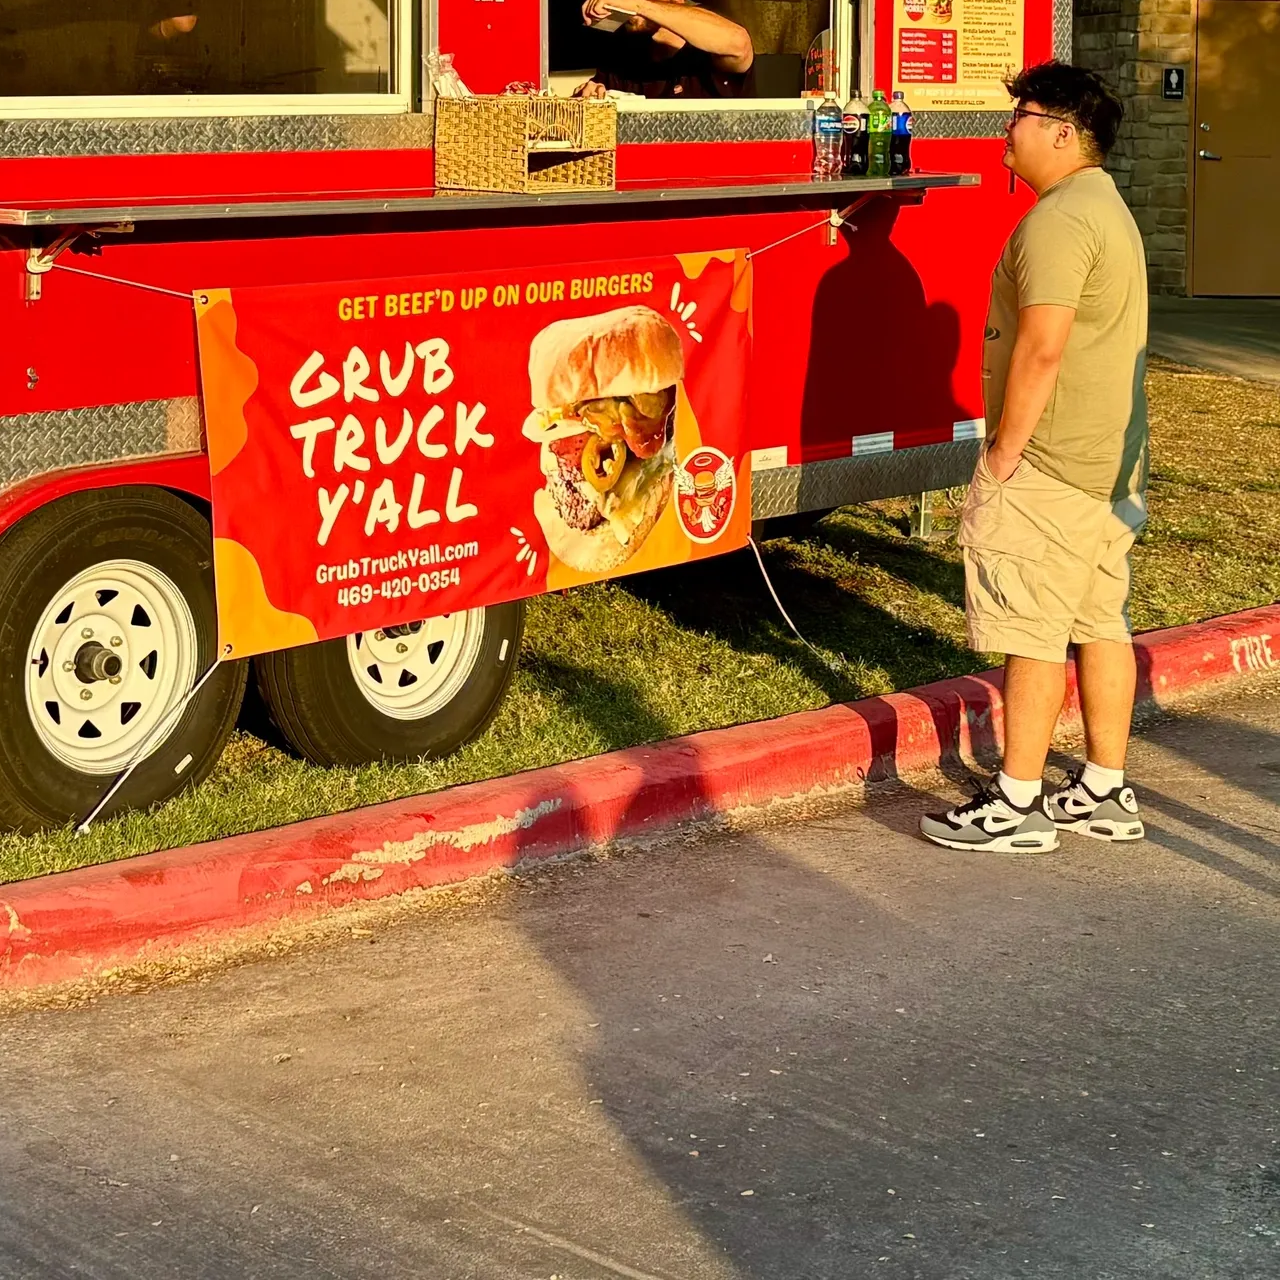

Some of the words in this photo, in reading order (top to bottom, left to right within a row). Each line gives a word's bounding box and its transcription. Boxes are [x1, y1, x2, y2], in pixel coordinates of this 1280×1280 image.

[339, 295, 378, 321] GET
[384, 286, 455, 317] BEEF'D
[460, 286, 489, 310] UP
[493, 283, 521, 307] ON
[525, 279, 565, 305] OUR
[570, 272, 654, 300] BURGERS
[289, 337, 455, 410] GRUB
[289, 401, 495, 479] TRUCK
[317, 468, 479, 547] Y'ALL
[316, 539, 479, 584] GrubTruckYall.com
[337, 567, 460, 607] 469-420-0354
